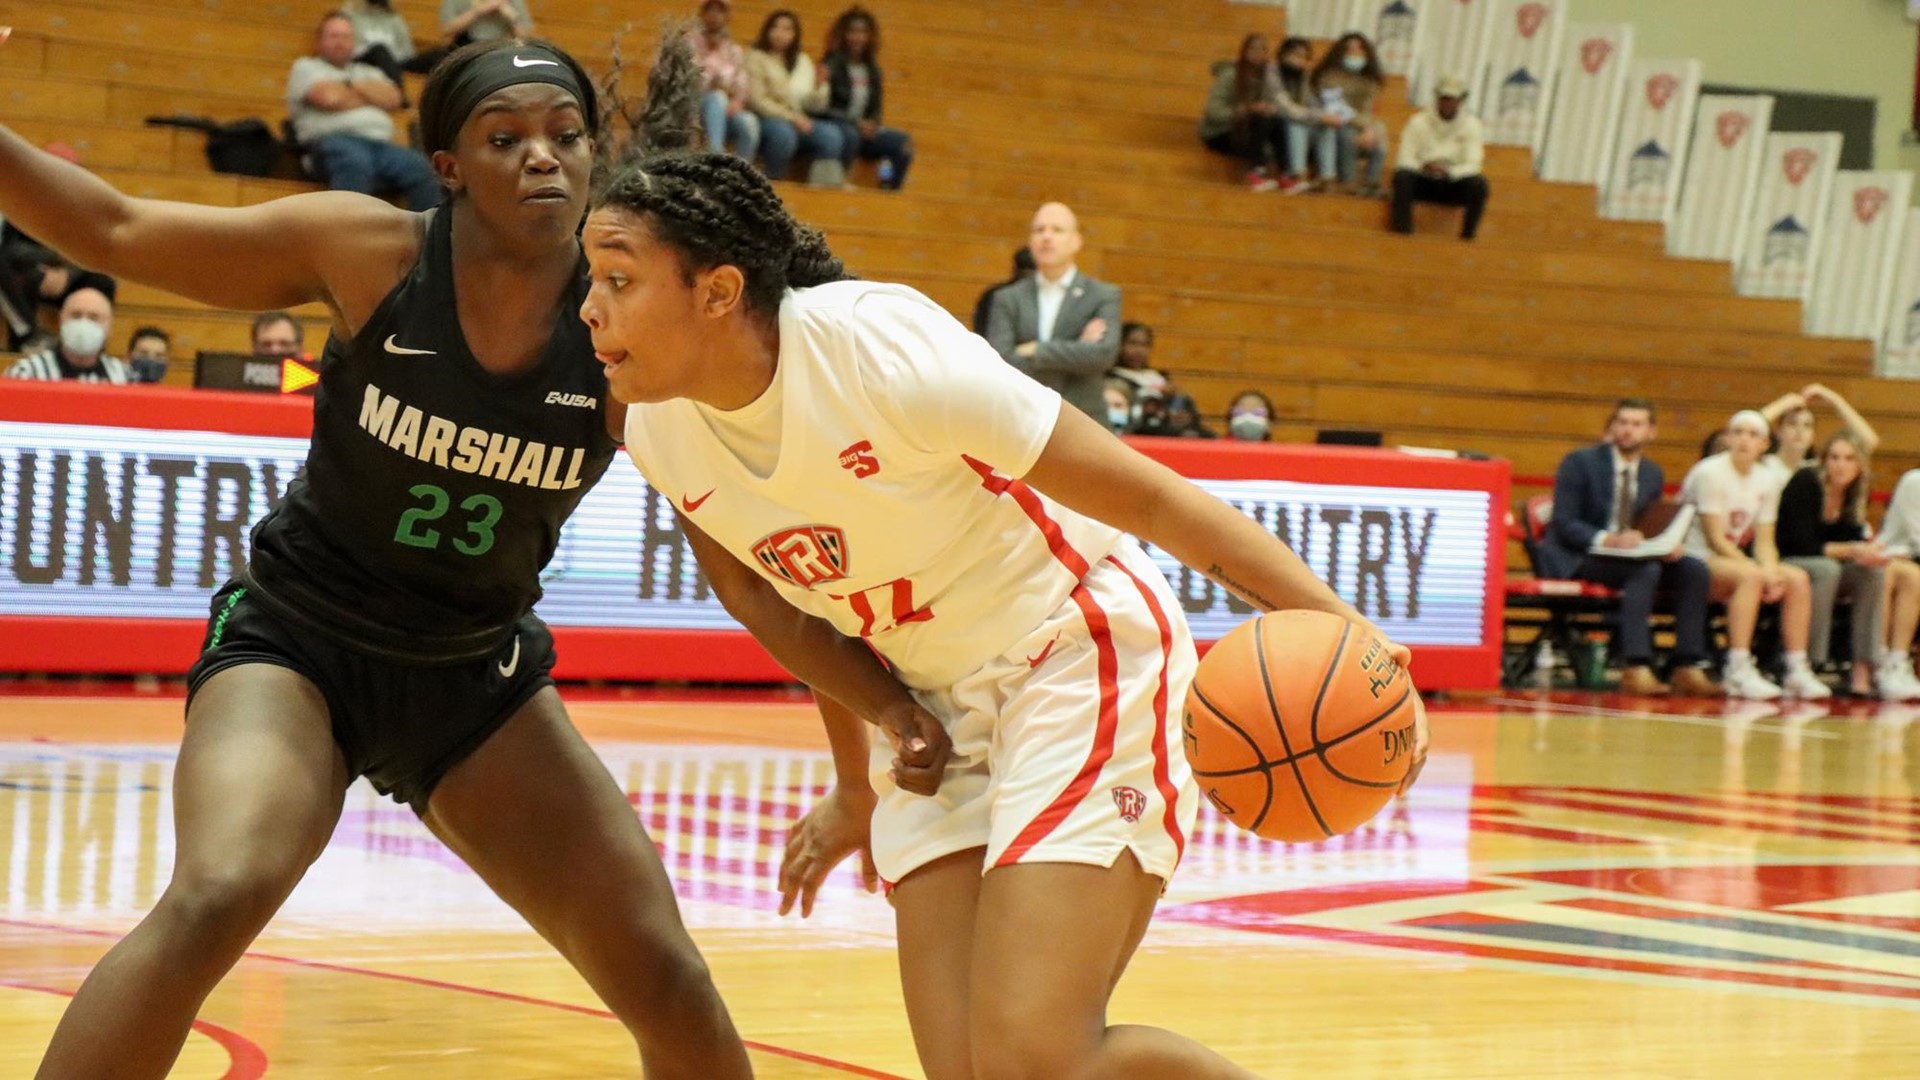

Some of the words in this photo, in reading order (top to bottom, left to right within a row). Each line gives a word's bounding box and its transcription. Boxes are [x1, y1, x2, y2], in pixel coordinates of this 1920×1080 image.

[359, 383, 586, 490] MARSHALL
[0, 453, 306, 590] UNTR
[394, 484, 504, 557] 23
